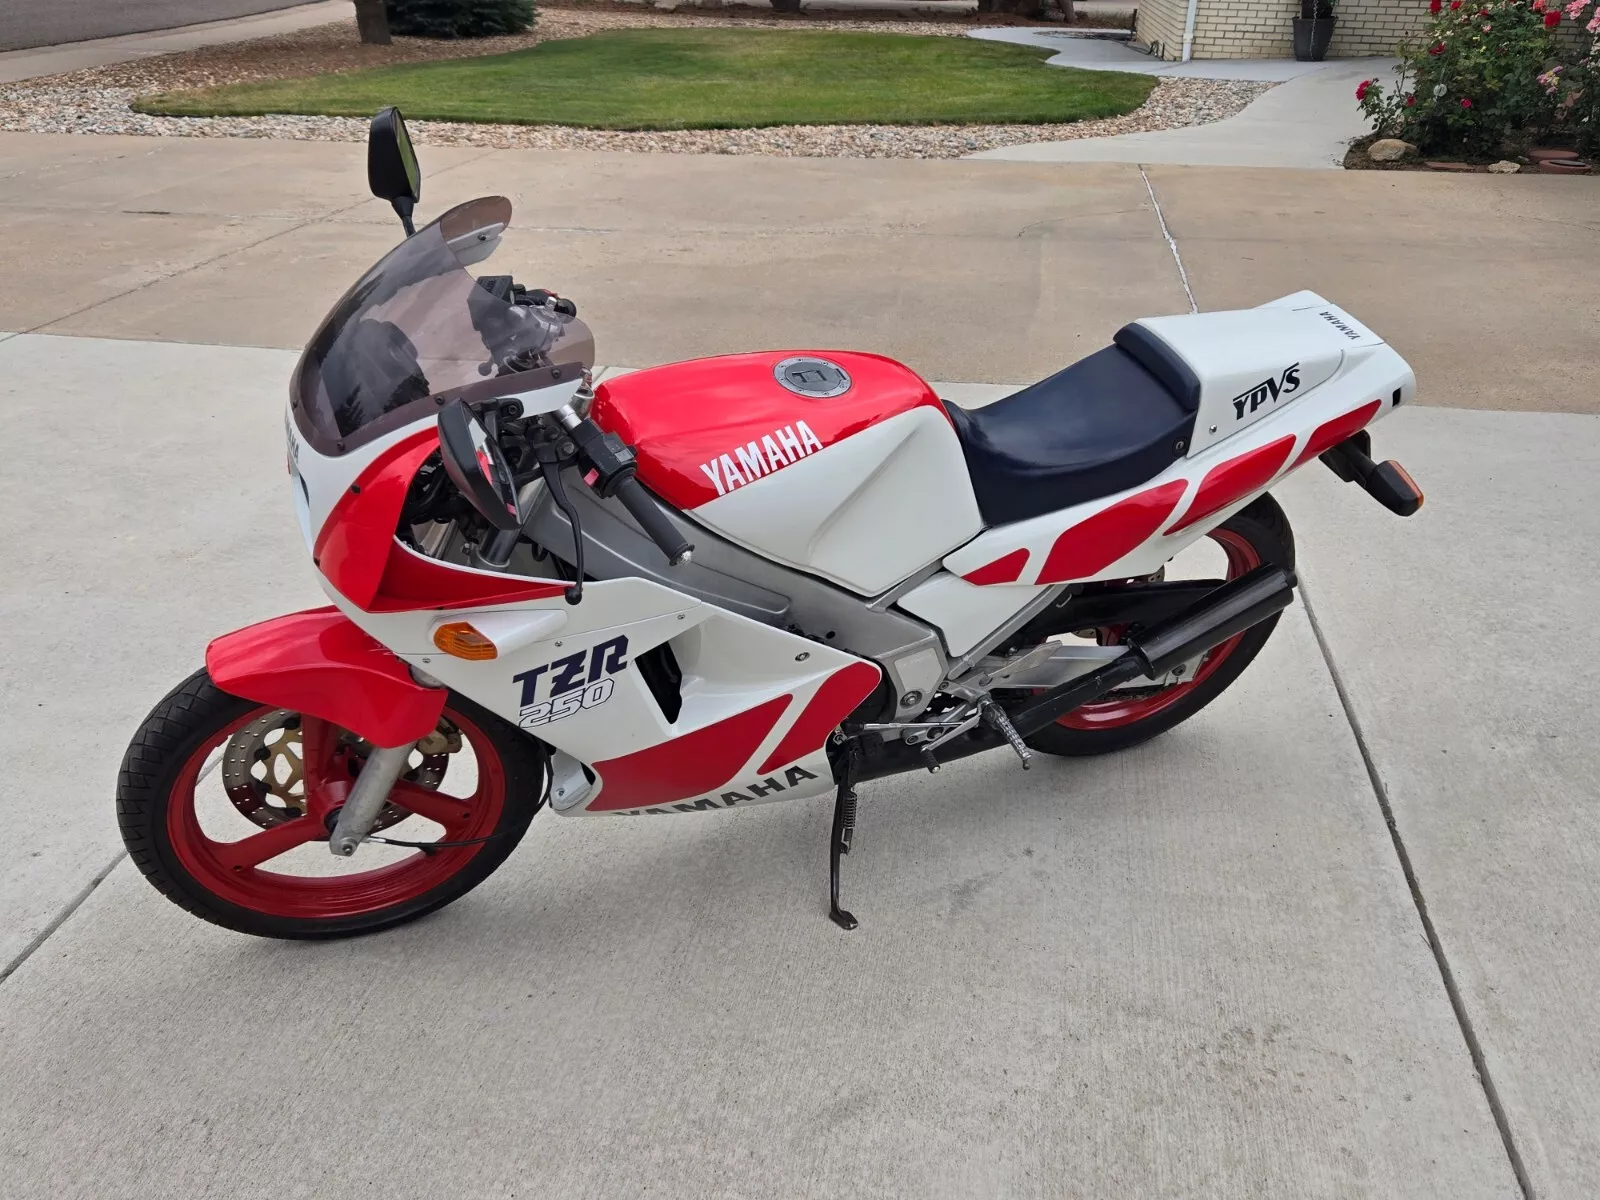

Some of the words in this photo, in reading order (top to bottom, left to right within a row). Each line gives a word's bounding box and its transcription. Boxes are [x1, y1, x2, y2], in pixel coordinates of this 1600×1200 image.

[1319, 311, 1361, 340] YAMAHA
[1232, 361, 1300, 420] YPVS
[699, 420, 824, 497] YAMAHA
[512, 634, 629, 708] TZR
[518, 677, 615, 729] 250
[612, 764, 818, 816] MAHA
